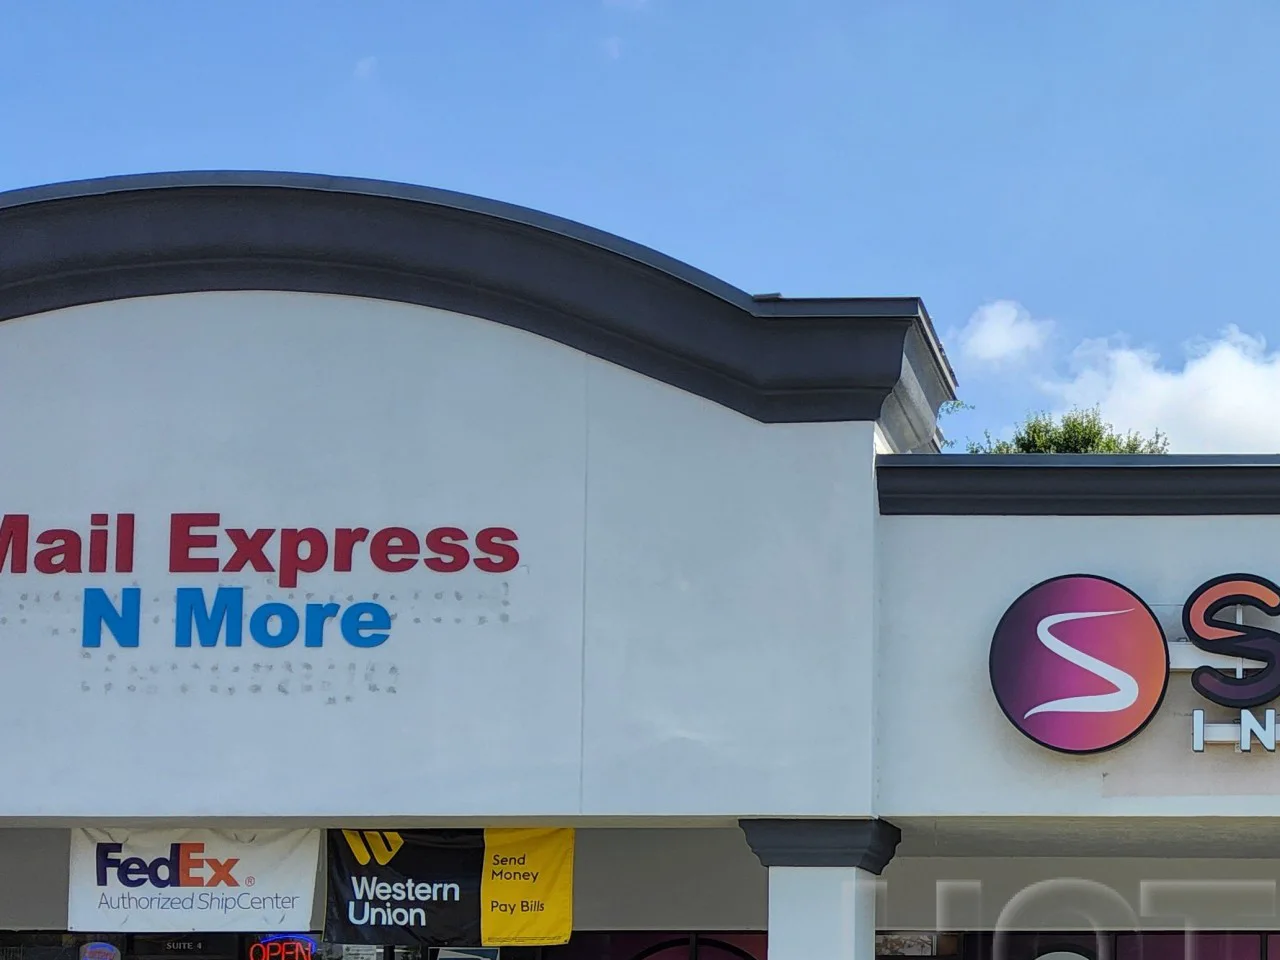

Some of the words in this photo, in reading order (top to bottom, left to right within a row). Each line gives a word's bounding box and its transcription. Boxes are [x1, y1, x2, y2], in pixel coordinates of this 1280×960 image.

[169, 513, 519, 588] Express
[81, 587, 141, 648] N
[175, 587, 392, 648] More
[96, 843, 240, 888] FedEx
[492, 854, 525, 866] Send
[491, 869, 539, 883] Money
[351, 876, 460, 901] Western
[98, 892, 194, 910] Authorized
[197, 892, 300, 914] ShipCenter
[348, 901, 426, 926] Union
[491, 901, 516, 915] Pay
[521, 901, 545, 912] Bills
[166, 942, 193, 950] SUITE
